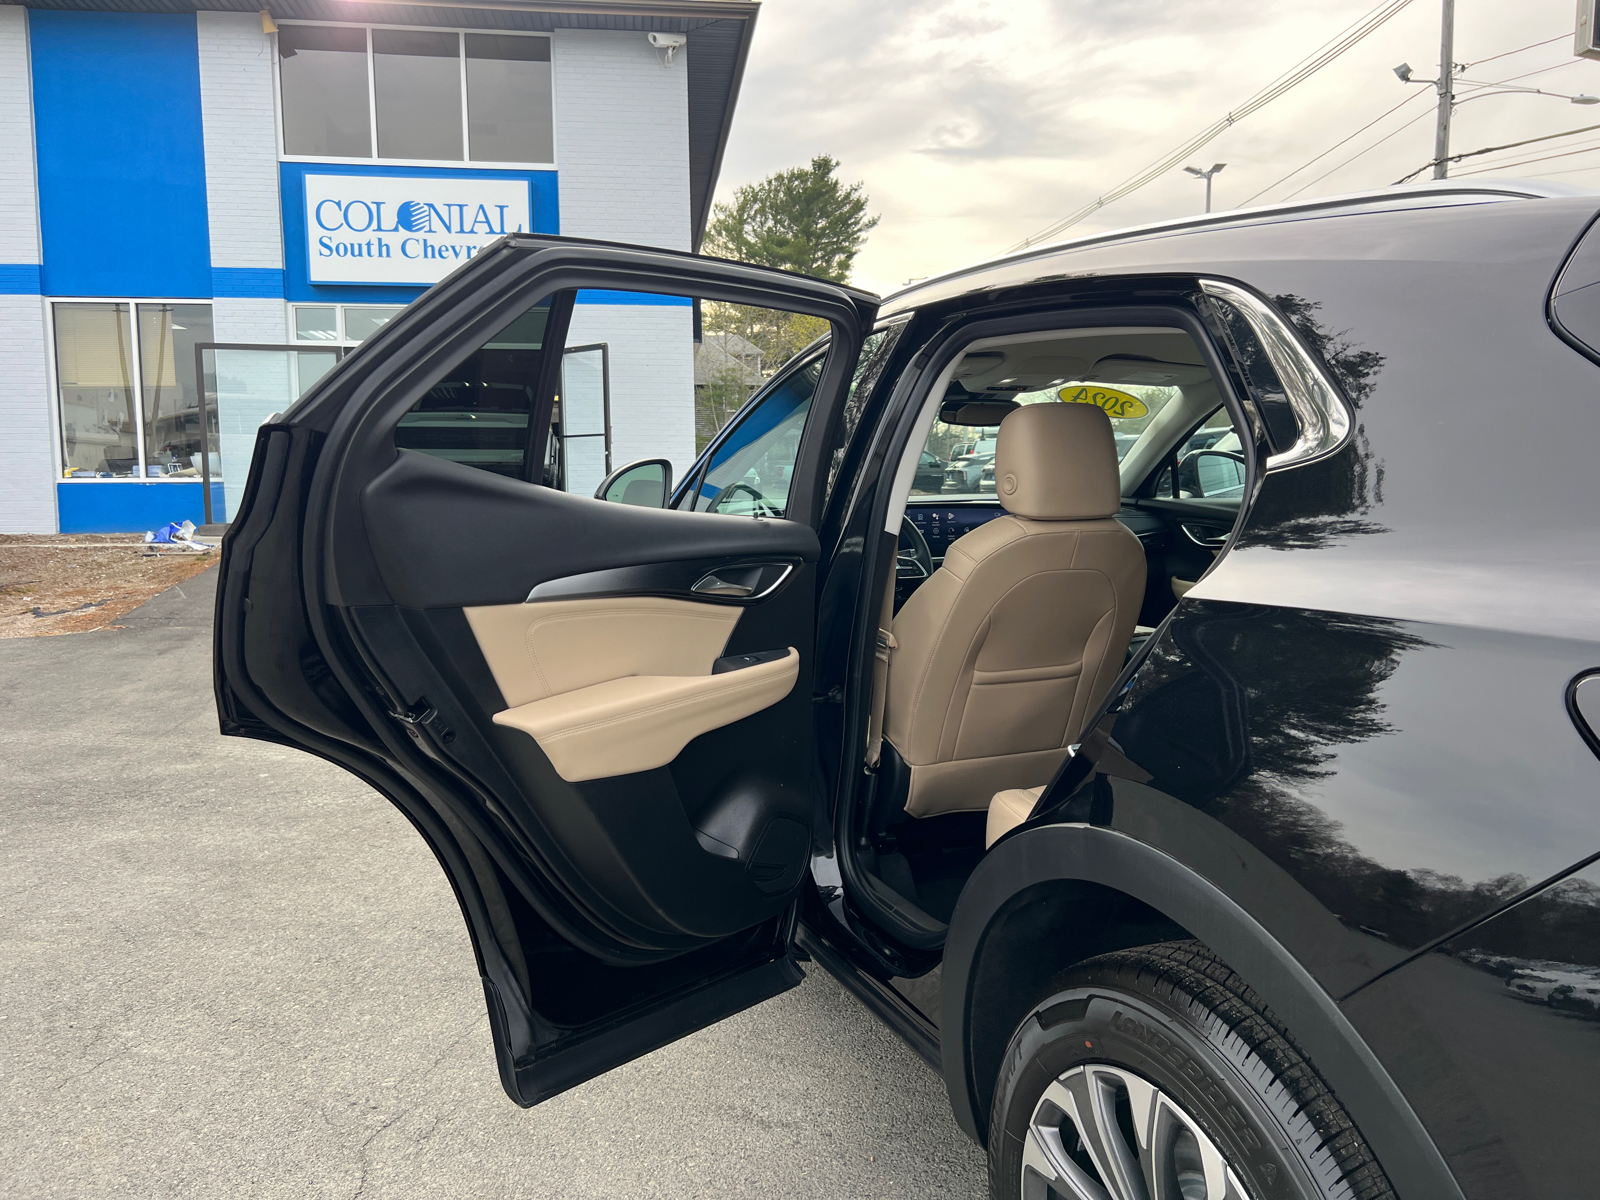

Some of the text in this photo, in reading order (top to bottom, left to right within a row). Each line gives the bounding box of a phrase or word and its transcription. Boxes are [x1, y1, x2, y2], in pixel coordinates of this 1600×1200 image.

[315, 199, 522, 235] COLONIAL
[319, 235, 484, 260] South Chevr
